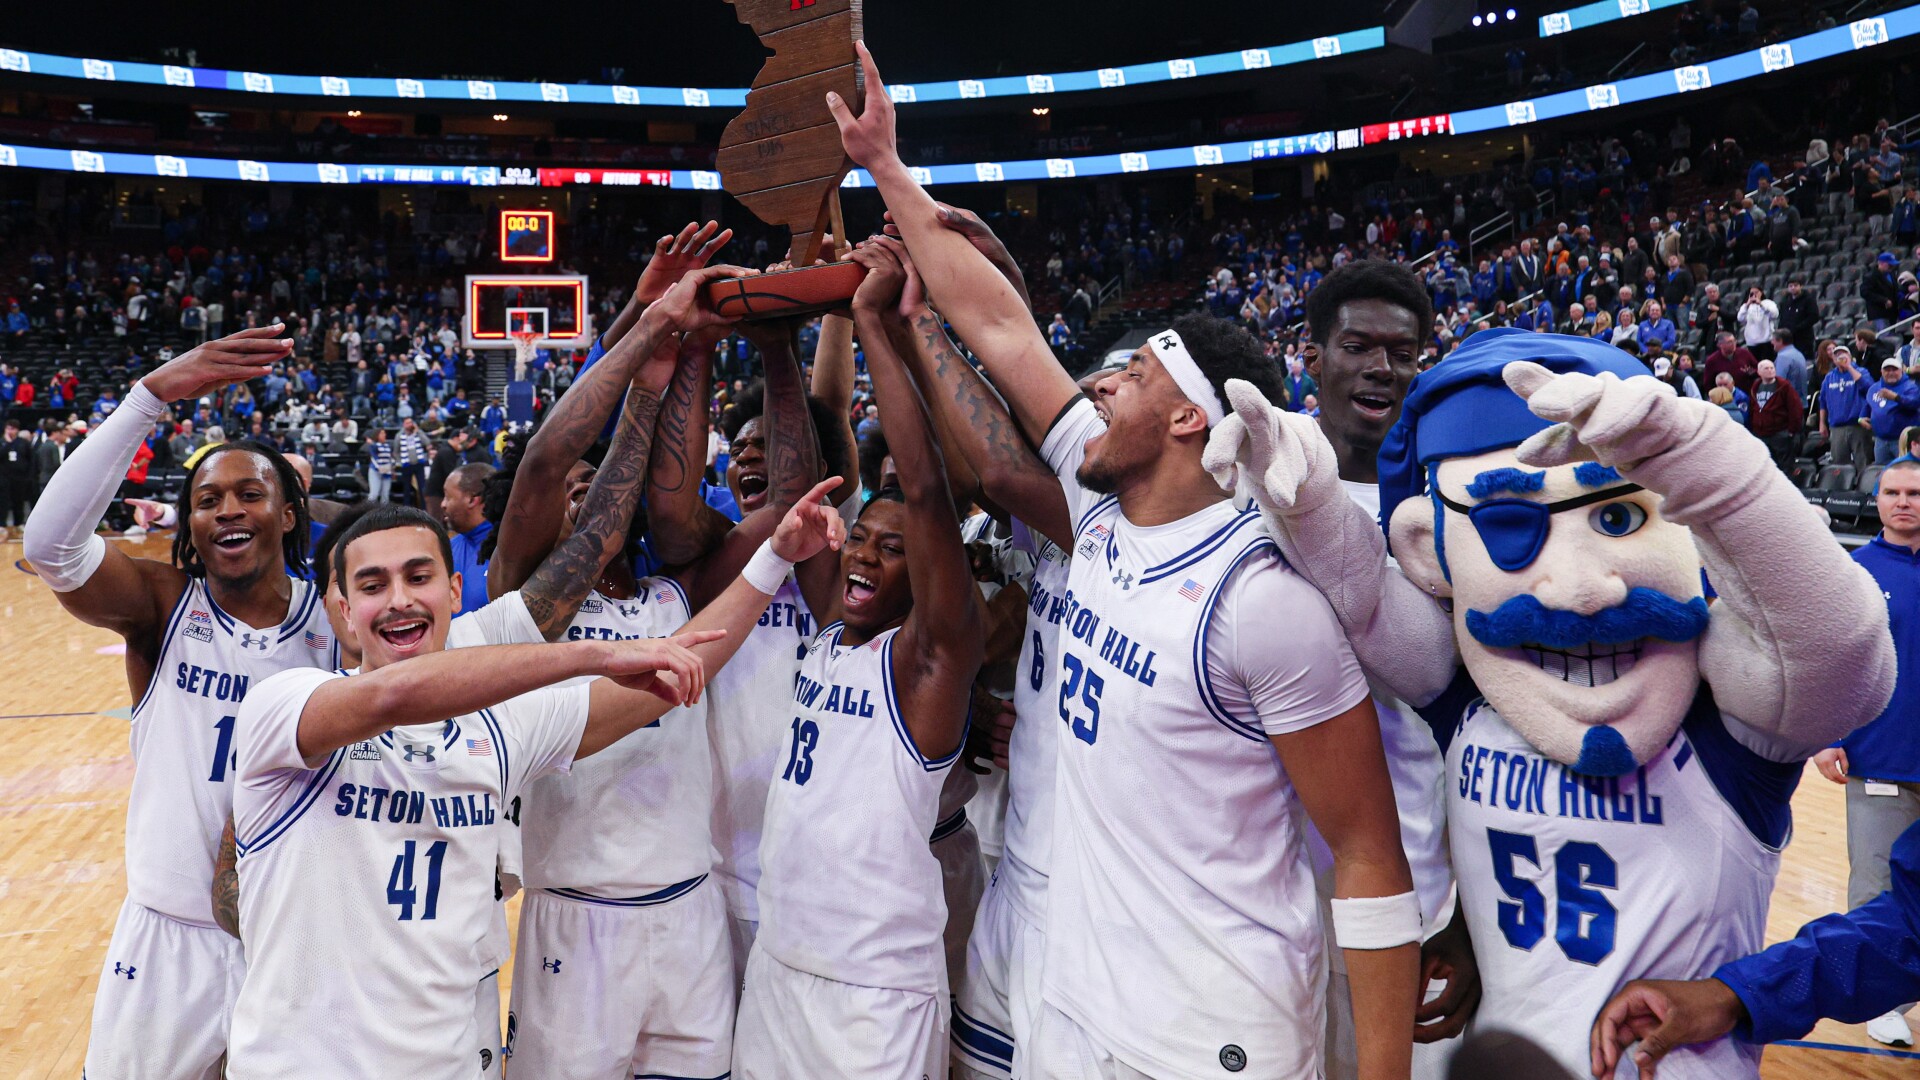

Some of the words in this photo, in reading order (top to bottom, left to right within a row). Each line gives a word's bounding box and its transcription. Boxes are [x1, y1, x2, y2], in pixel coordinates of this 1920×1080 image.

[507, 217, 539, 231] 00.0
[189, 623, 199, 631] BE
[199, 627, 212, 636] THE
[580, 605, 602, 613] HANGE
[184, 629, 212, 642] CHANGE
[1100, 626, 1157, 688] HALL
[176, 661, 249, 703] SETON
[1030, 630, 1044, 693] 6
[818, 684, 875, 719] ALL
[1059, 652, 1104, 746] 25
[208, 715, 237, 783] 1
[351, 751, 381, 760] CHANGE
[355, 742, 366, 750] BE
[781, 716, 820, 787] 13
[334, 782, 425, 824] SETON
[430, 793, 495, 827] HALL
[1459, 744, 1548, 817] SETON
[1559, 755, 1664, 825] HALL
[386, 840, 448, 921] 41
[1486, 826, 1619, 967] 56
